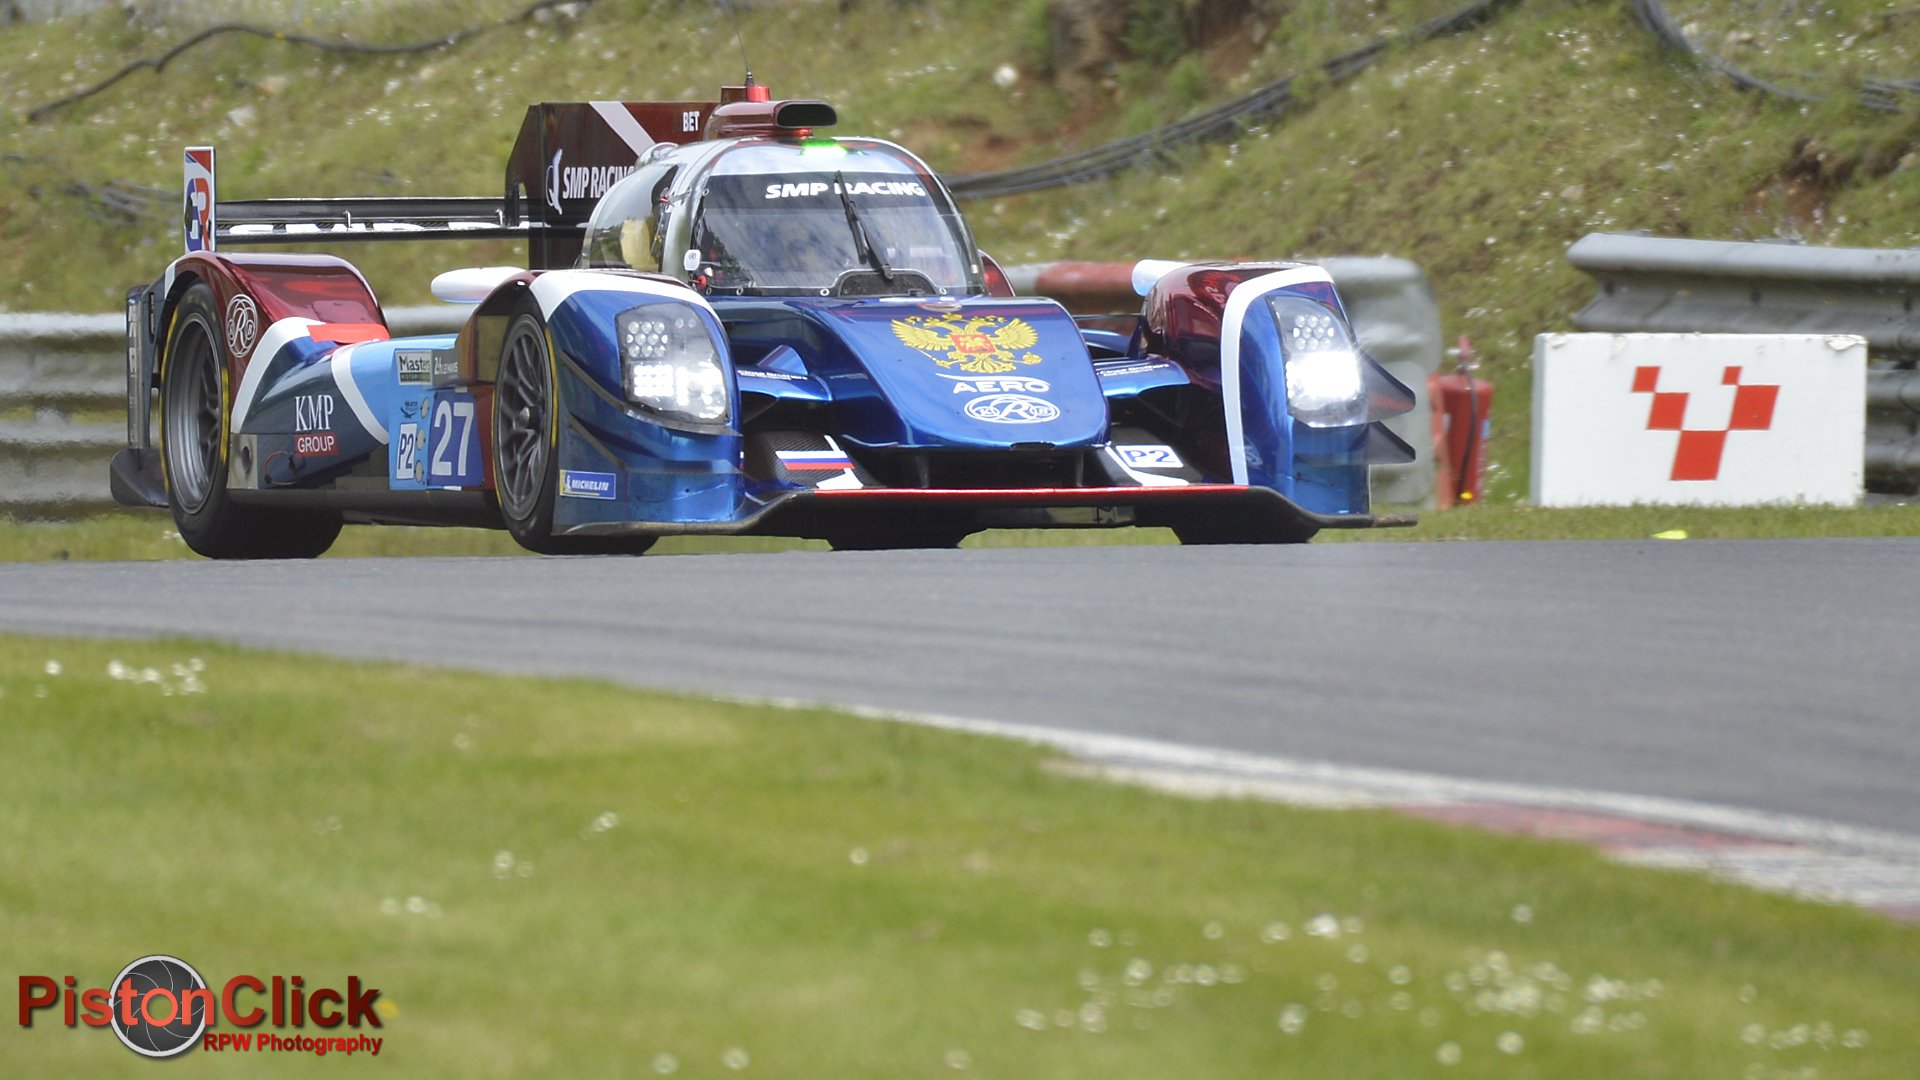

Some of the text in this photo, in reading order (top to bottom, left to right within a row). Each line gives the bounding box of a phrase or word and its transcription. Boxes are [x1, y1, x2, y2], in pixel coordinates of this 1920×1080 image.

[682, 111, 700, 131] BET
[562, 167, 590, 199] SMP
[765, 182, 926, 199] SMP RACING
[952, 381, 1050, 394] AERO
[295, 394, 334, 431] KMP
[297, 435, 335, 453] GROUP
[431, 400, 474, 476] 27
[398, 433, 414, 470] P2
[1123, 450, 1176, 462] P2
[571, 479, 609, 491] MICHELIN
